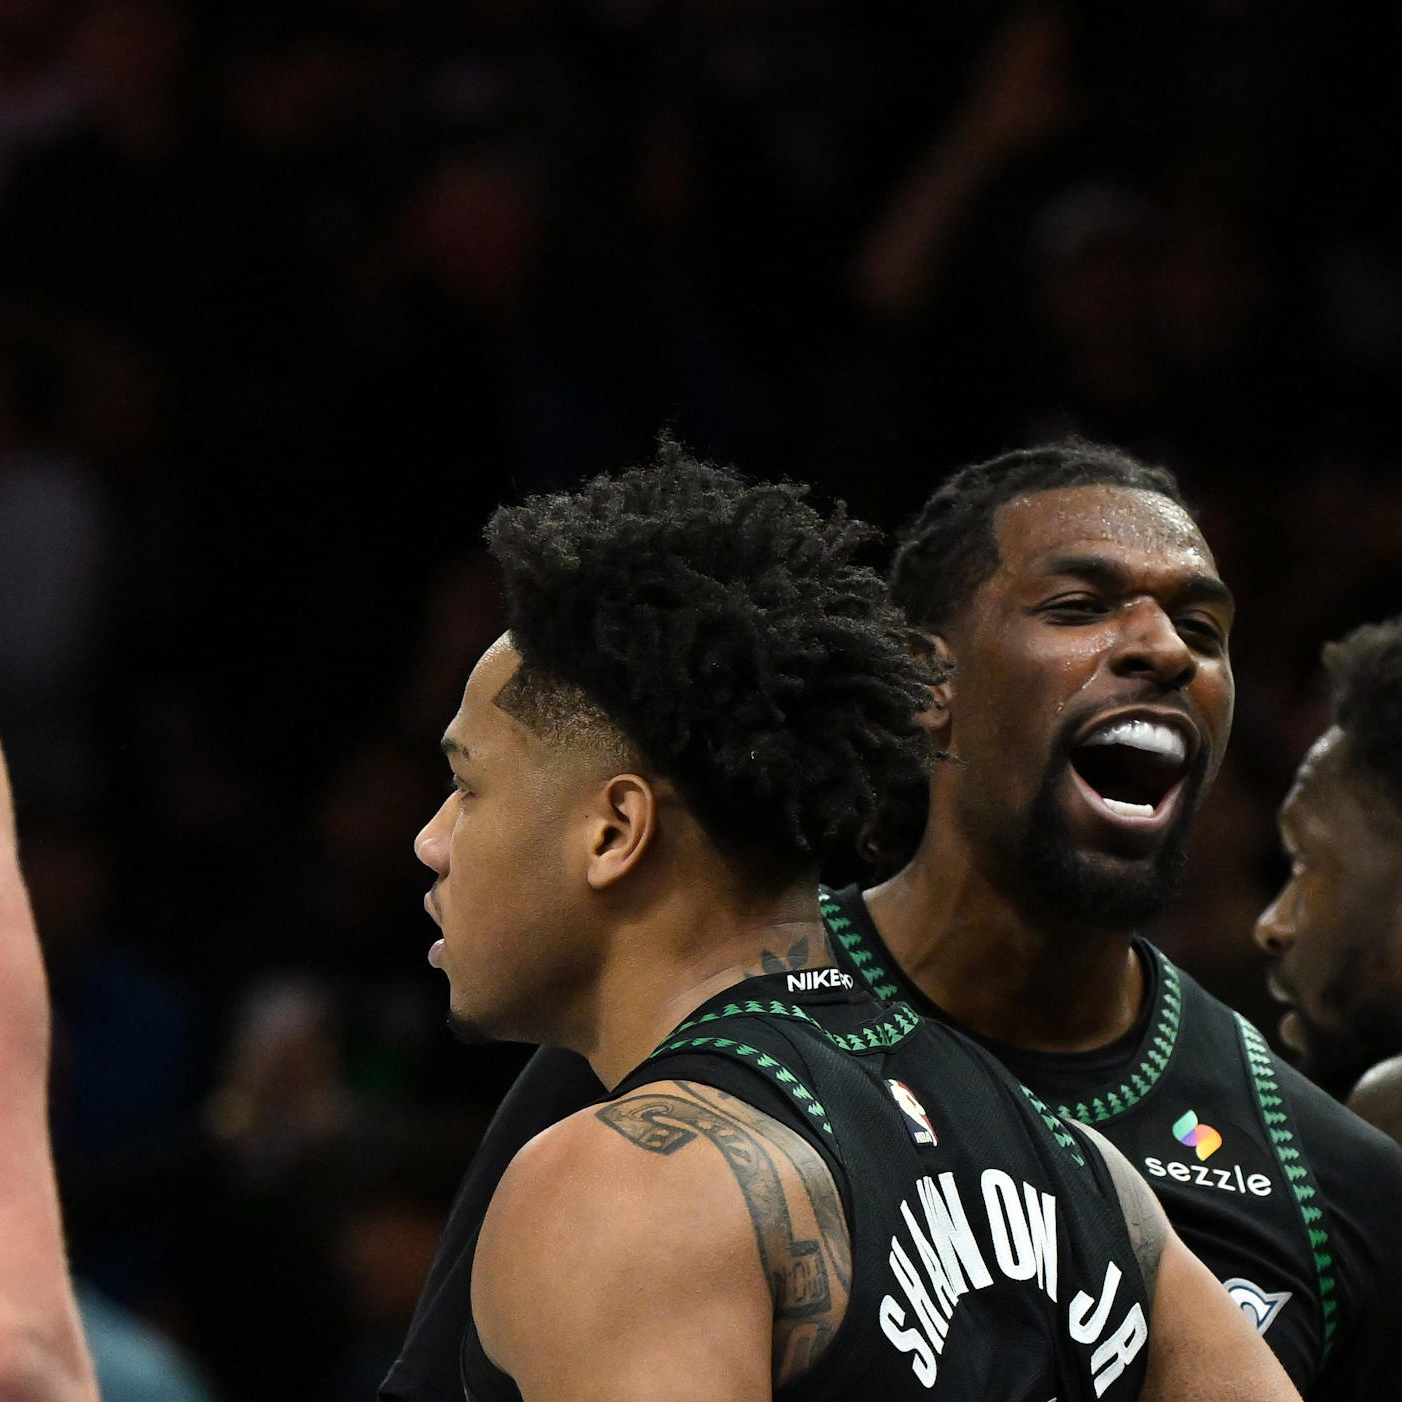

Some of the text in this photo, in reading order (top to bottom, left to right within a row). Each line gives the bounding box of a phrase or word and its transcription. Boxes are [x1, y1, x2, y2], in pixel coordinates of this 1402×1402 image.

[786, 968, 841, 992] NIKE
[1144, 1156, 1272, 1197] sezzle
[1068, 1260, 1148, 1399] JR
